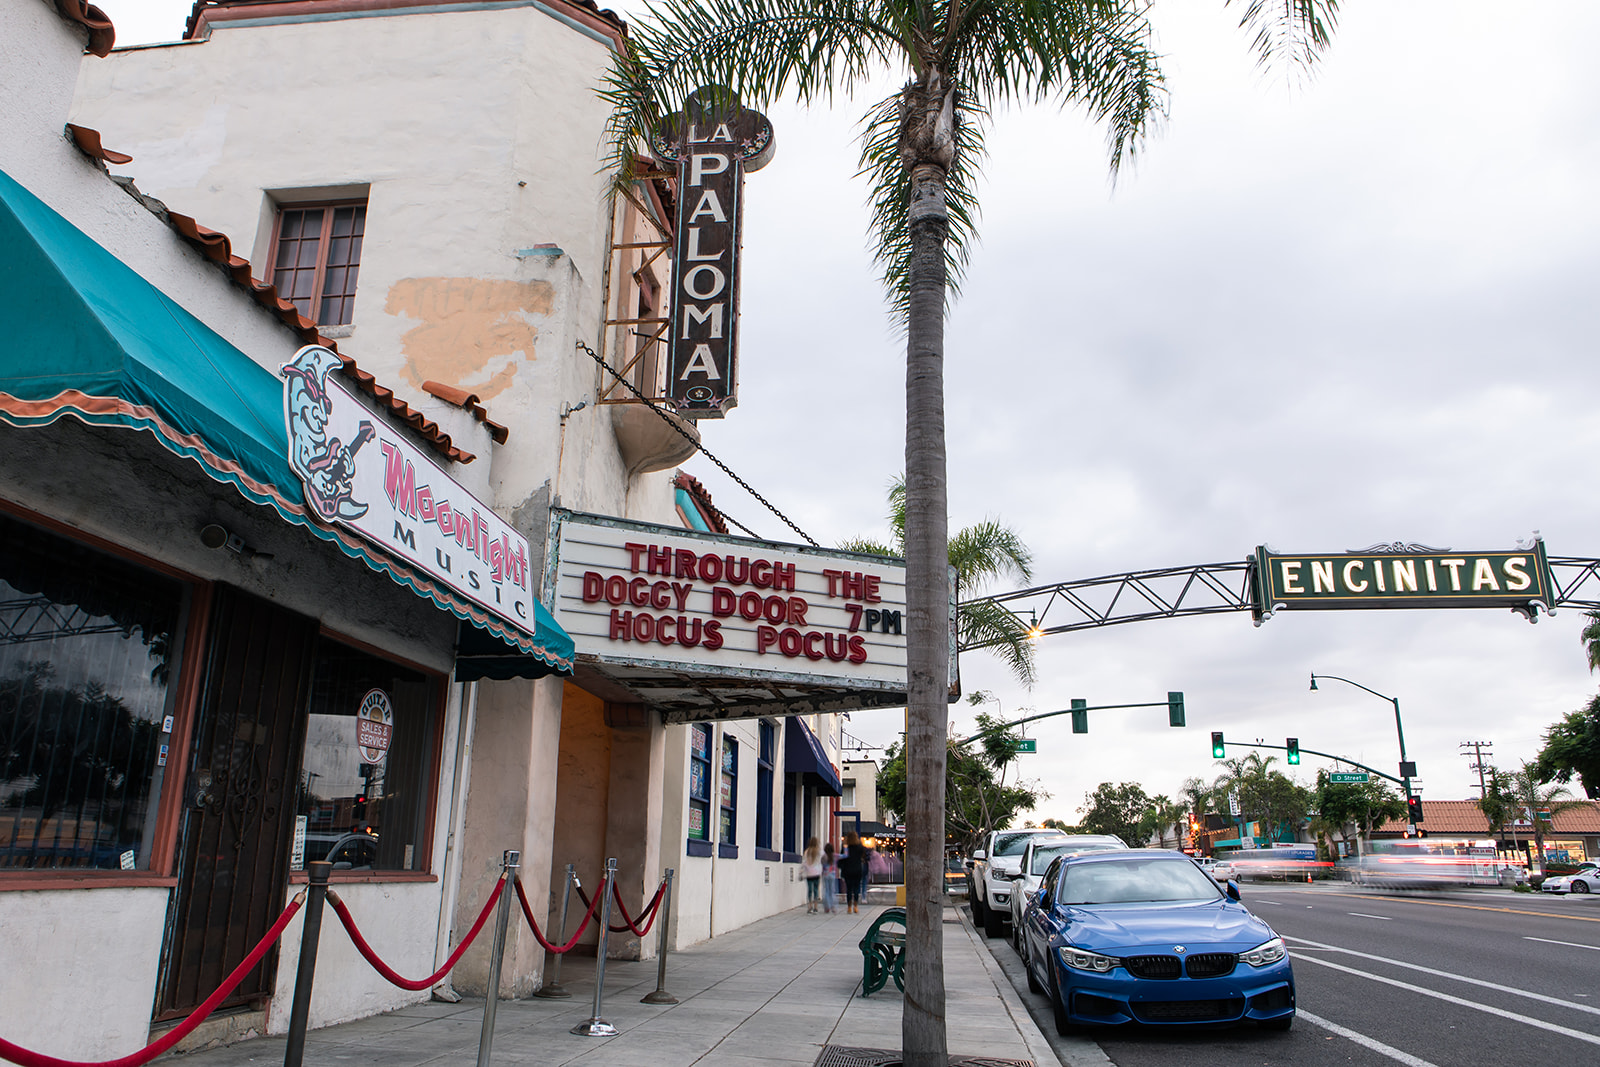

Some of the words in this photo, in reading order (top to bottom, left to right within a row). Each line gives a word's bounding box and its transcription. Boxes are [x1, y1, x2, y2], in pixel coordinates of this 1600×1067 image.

[687, 123, 735, 144] LA
[680, 153, 729, 381] PALOMA
[380, 438, 528, 592] Moonlight
[393, 520, 528, 620] MUSIC
[582, 570, 693, 613] DOGGY
[712, 586, 808, 627] DOOR
[625, 541, 796, 593] THROUGH
[823, 568, 881, 603] THE
[1280, 556, 1532, 594] ENCINITAS
[609, 608, 724, 650] HOCUS
[757, 625, 867, 665] POCUS
[361, 693, 391, 721] GUITAR
[361, 722, 383, 736] SALES
[383, 727, 388, 736] &
[360, 733, 388, 749] SERVICE
